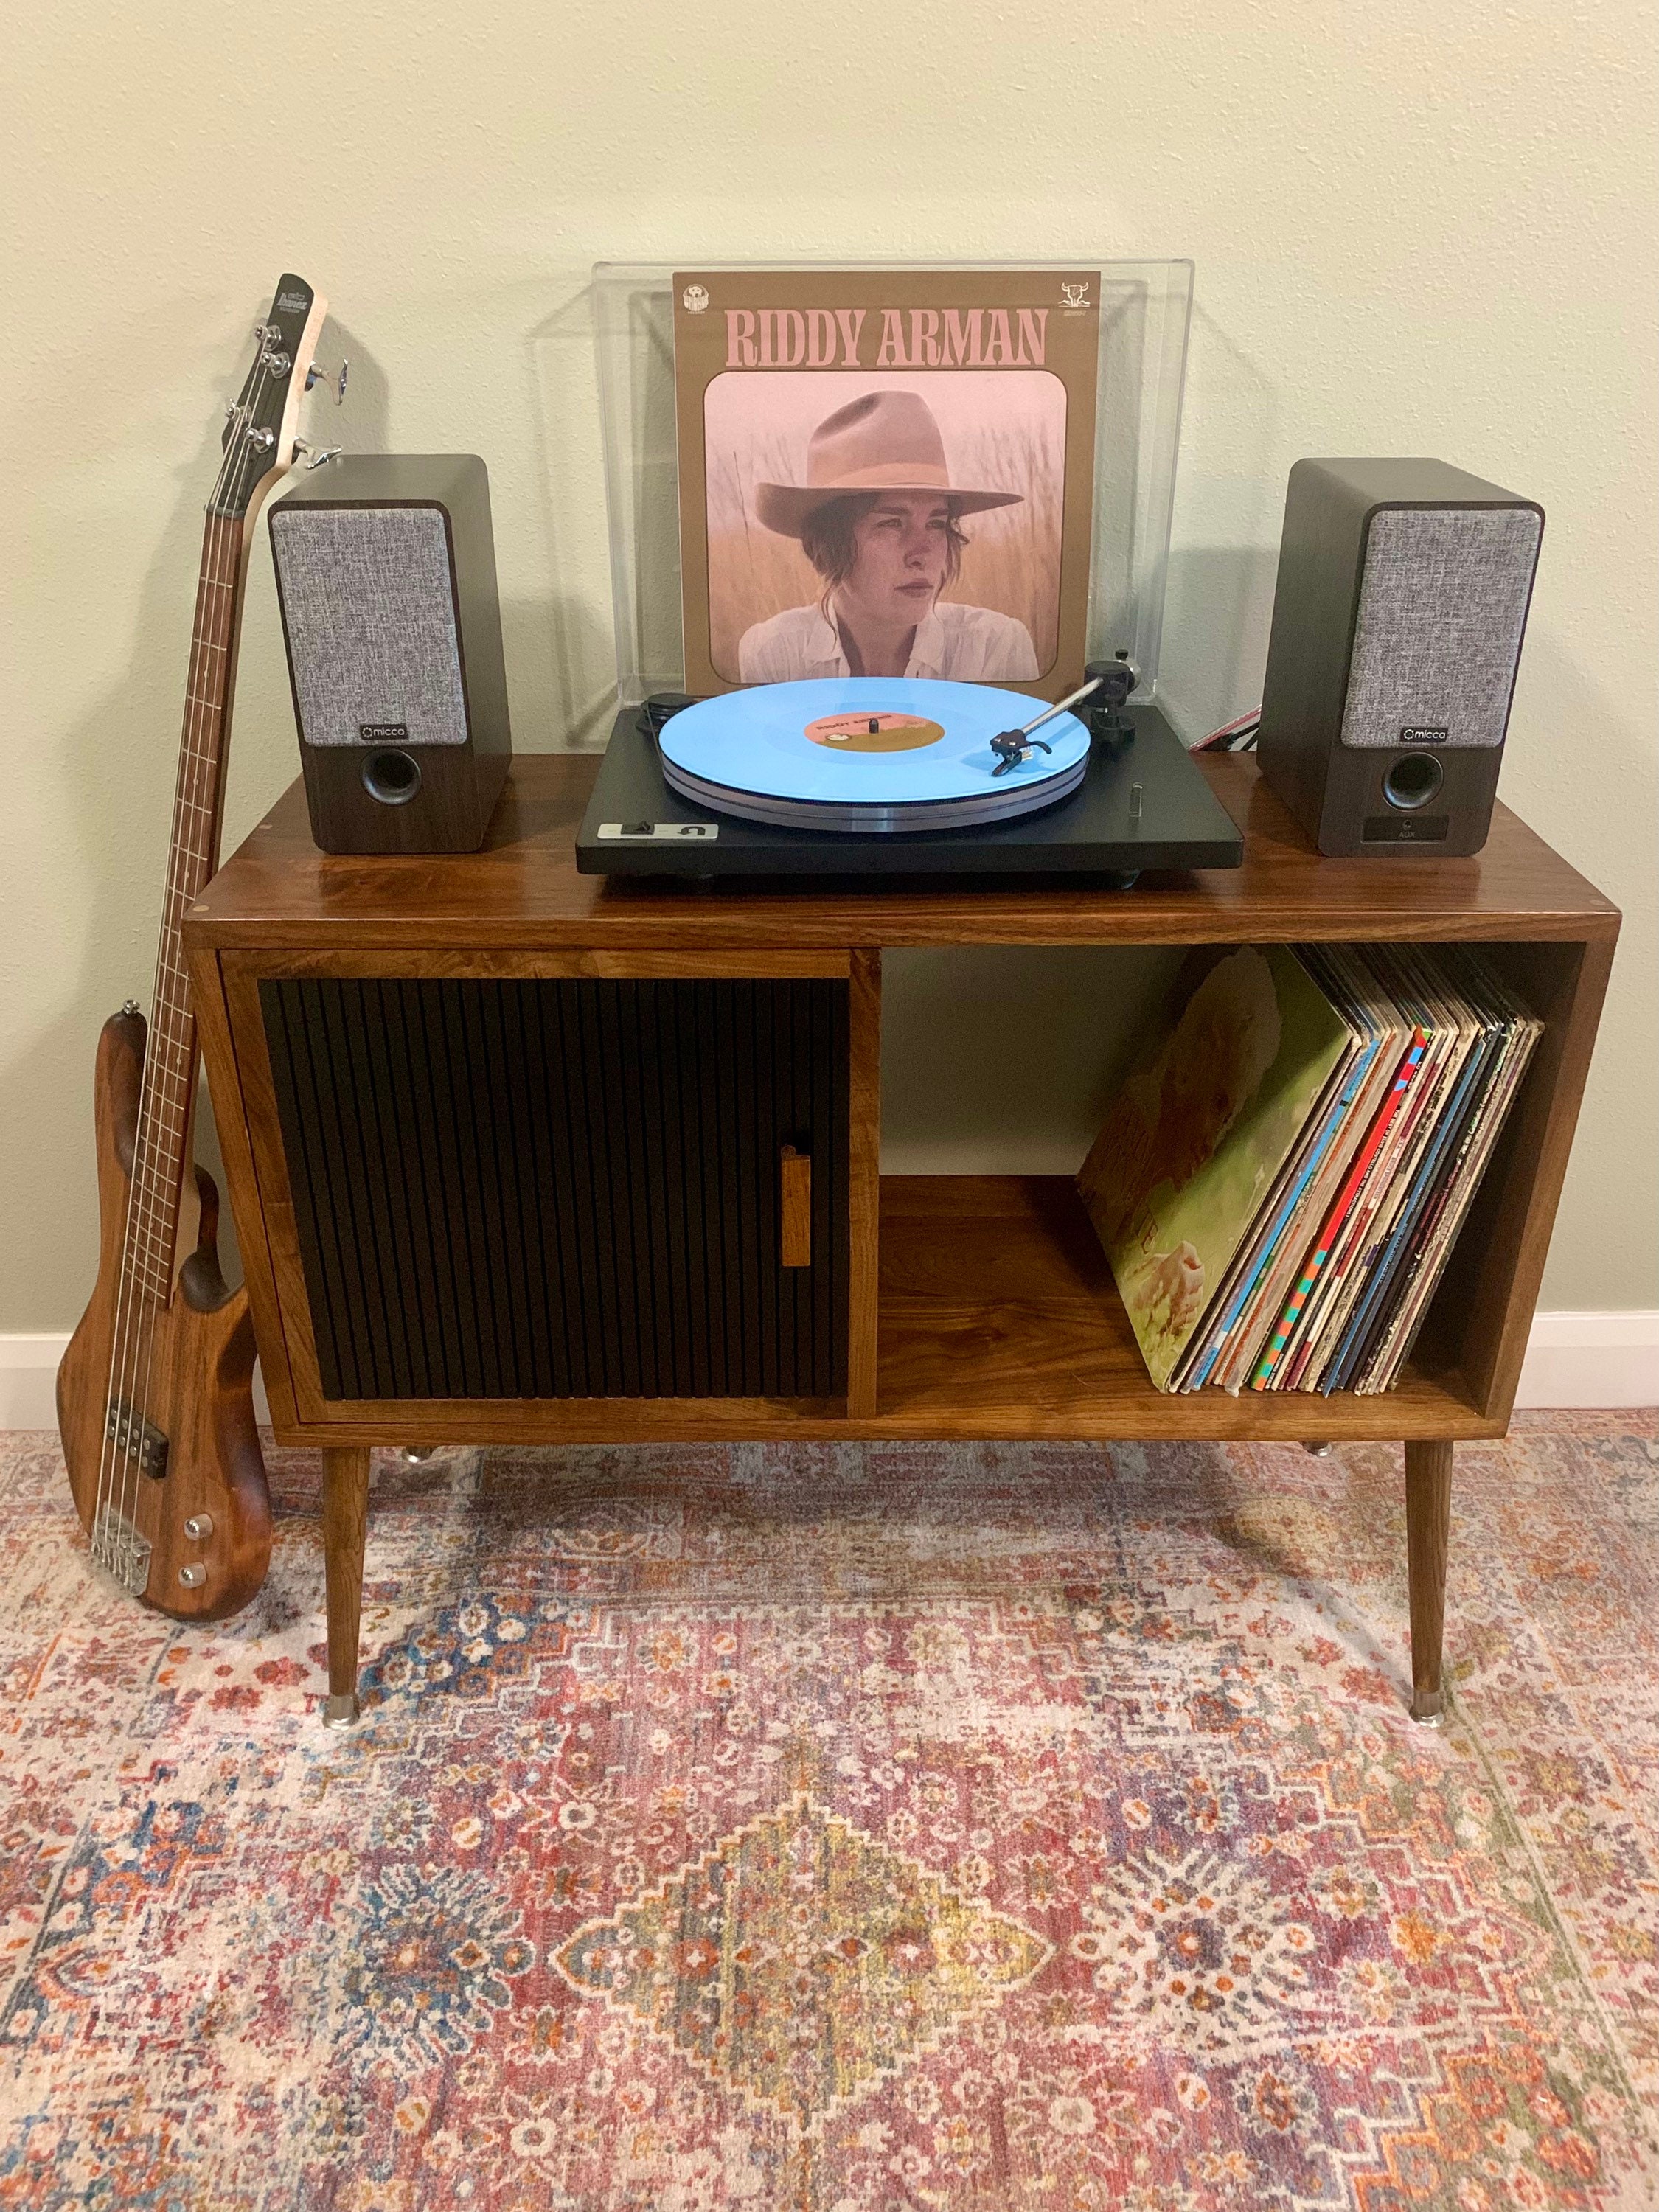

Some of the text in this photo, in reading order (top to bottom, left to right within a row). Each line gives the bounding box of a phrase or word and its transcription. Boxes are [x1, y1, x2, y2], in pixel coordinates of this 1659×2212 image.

[277, 293, 307, 310] Ibanez
[725, 309, 1049, 366] RIDDY ARMAN
[373, 727, 405, 737] micca
[1415, 729, 1446, 740] micca
[1367, 1147, 1381, 1170] COSTELLO
[1346, 1186, 1363, 1214] ATTRACTIONS
